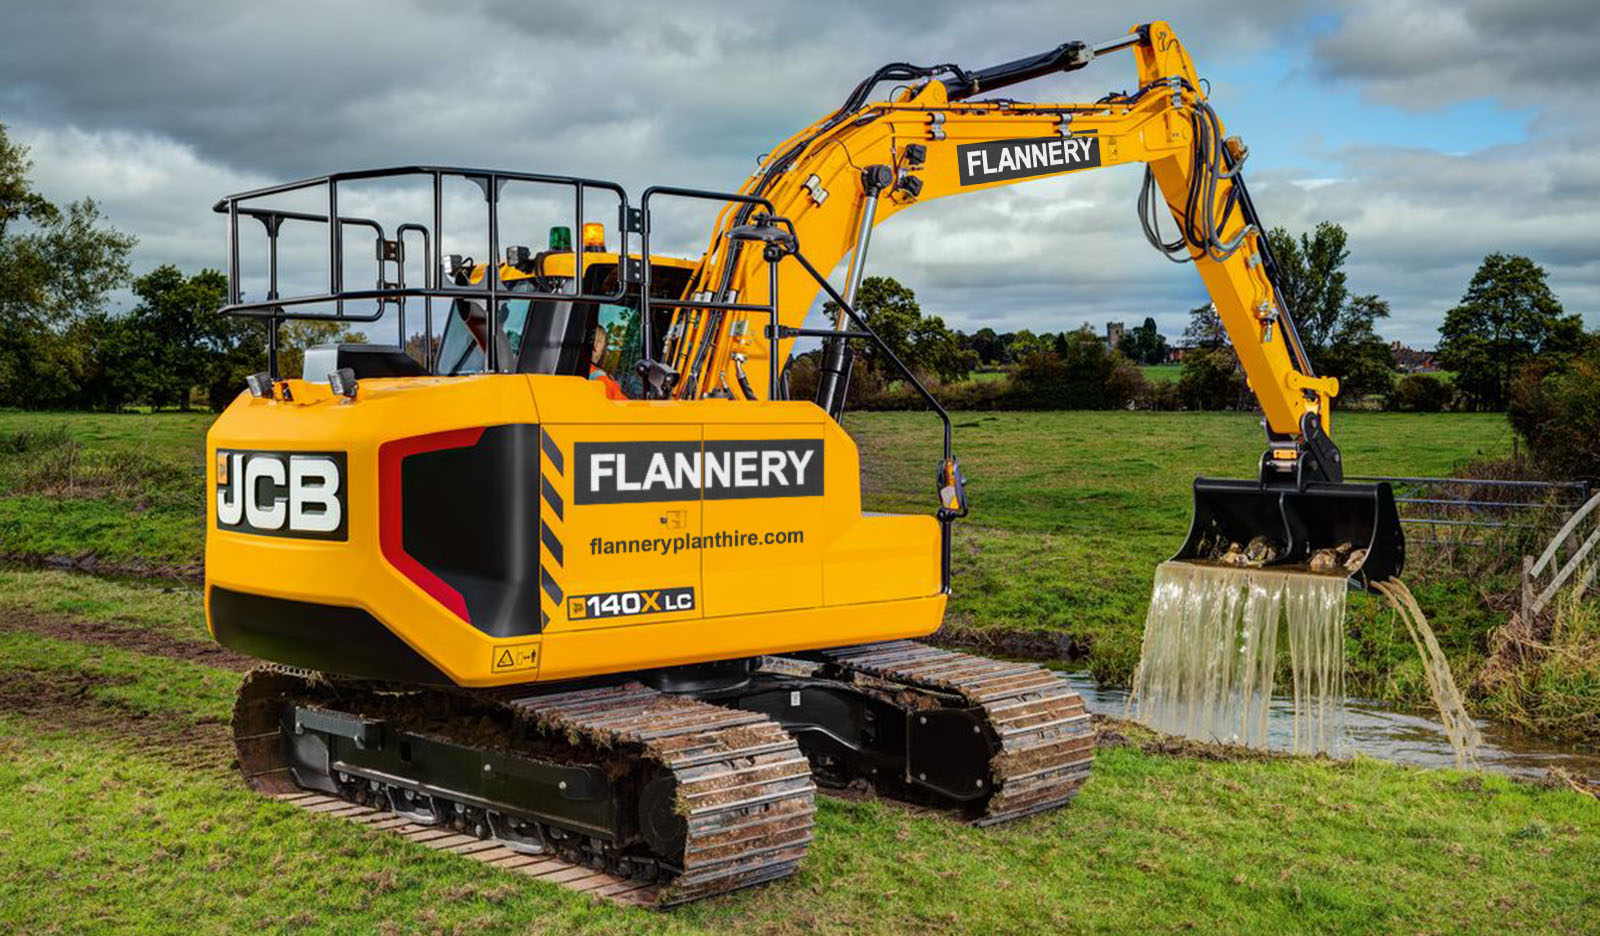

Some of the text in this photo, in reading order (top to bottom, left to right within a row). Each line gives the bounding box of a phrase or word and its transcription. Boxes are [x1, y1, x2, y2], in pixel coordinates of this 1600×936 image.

[966, 137, 1094, 177] FLANNERY
[590, 450, 814, 492] FLANNERY
[217, 453, 341, 532] JCB
[590, 529, 804, 555] flanneryplanthire.com
[586, 592, 692, 616] 140X LC
